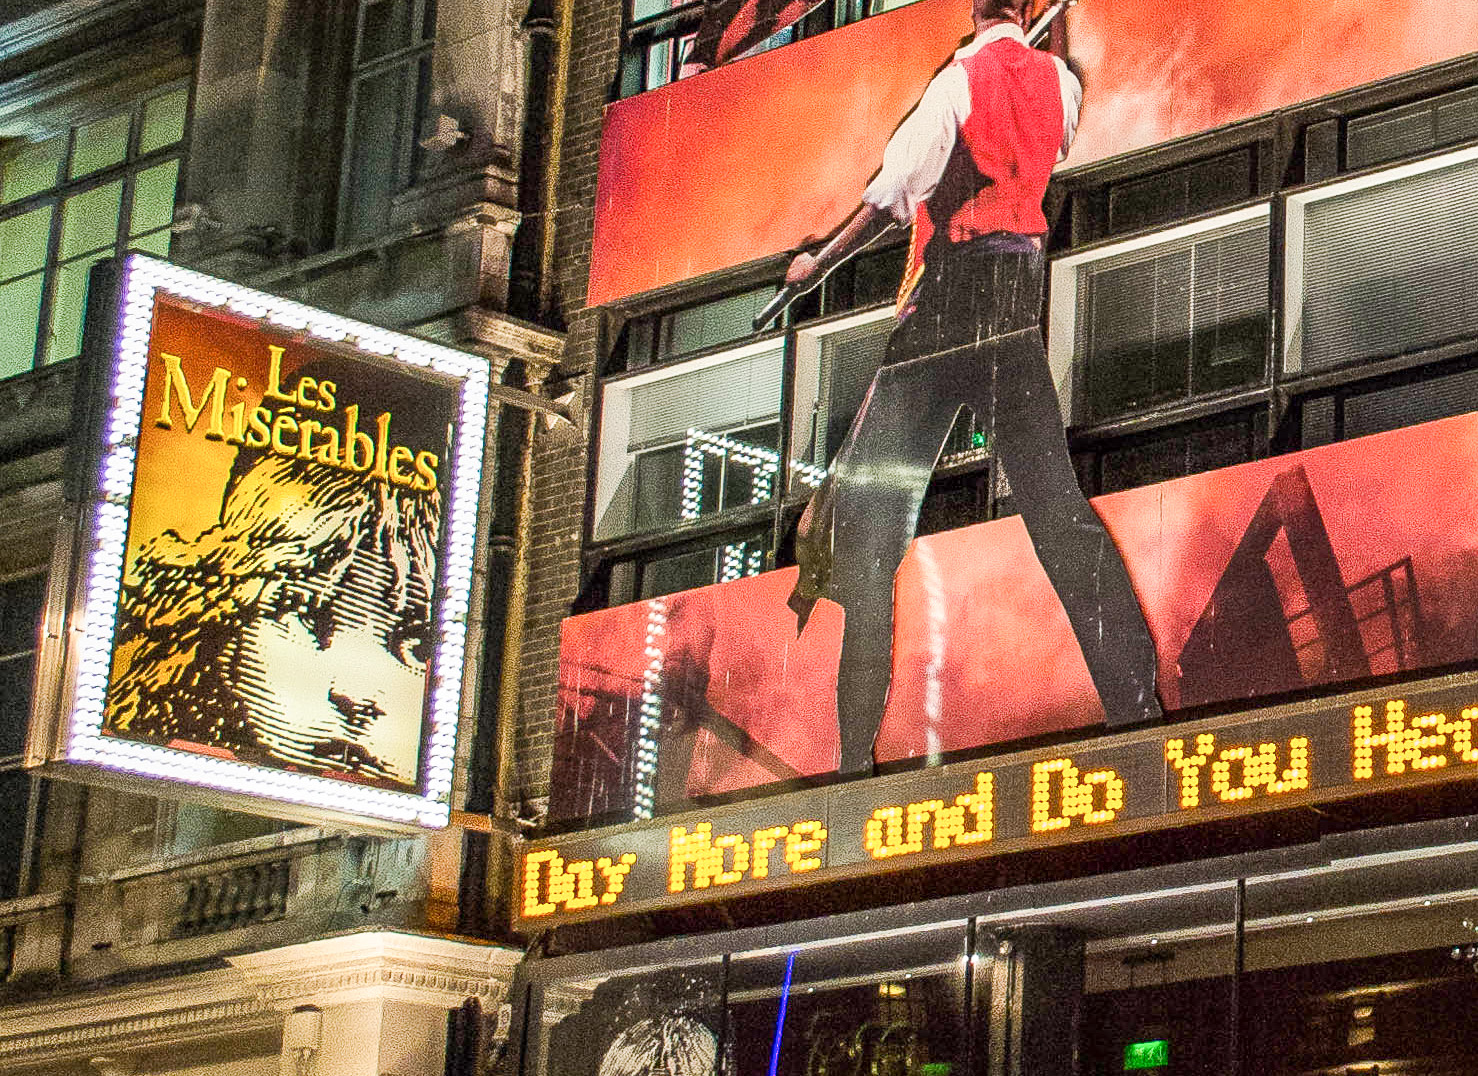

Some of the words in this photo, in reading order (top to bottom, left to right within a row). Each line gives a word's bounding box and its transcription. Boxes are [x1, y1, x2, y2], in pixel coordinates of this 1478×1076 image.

[155, 352, 439, 491] Misérables
[263, 344, 337, 412] Les
[522, 850, 637, 917] Day
[668, 821, 828, 893] More
[864, 772, 994, 860] and
[1031, 758, 1124, 833] Do
[1165, 734, 1309, 809] You
